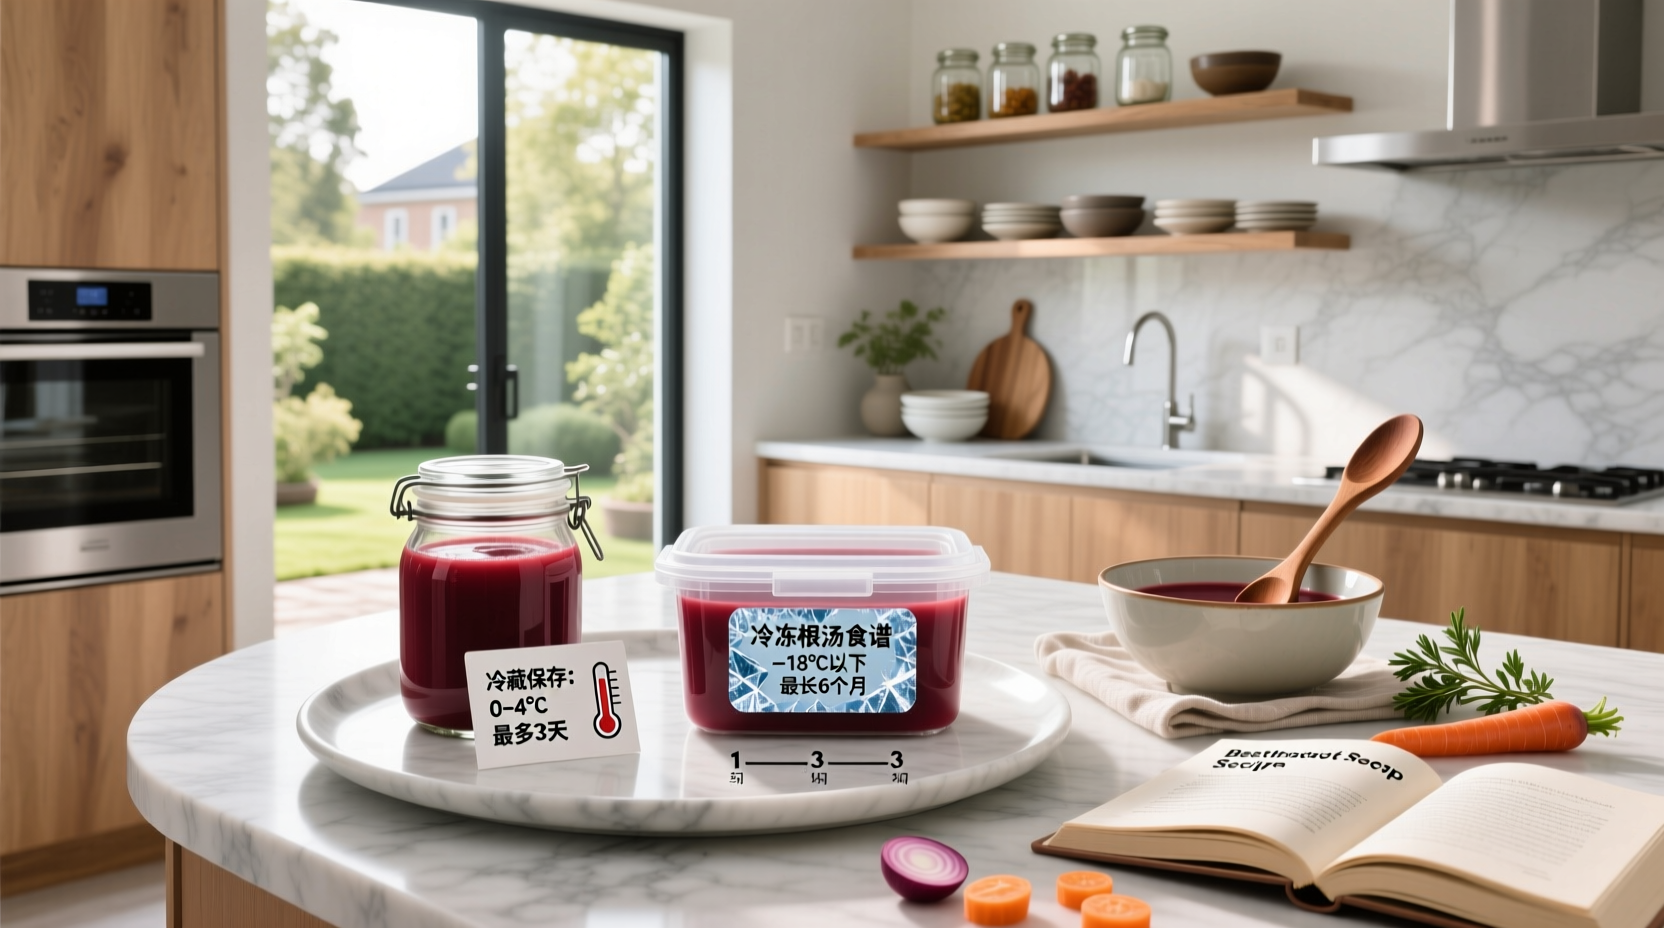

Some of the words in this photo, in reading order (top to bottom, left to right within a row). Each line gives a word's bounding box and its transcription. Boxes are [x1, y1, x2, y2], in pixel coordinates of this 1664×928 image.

[750, 622, 893, 649] 冷冻根汤食谱
[779, 675, 866, 696] 最长6个月
[492, 719, 569, 747] 最多3天
[730, 750, 740, 769] 1
[810, 750, 825, 769] 3
[890, 750, 904, 769] 3
